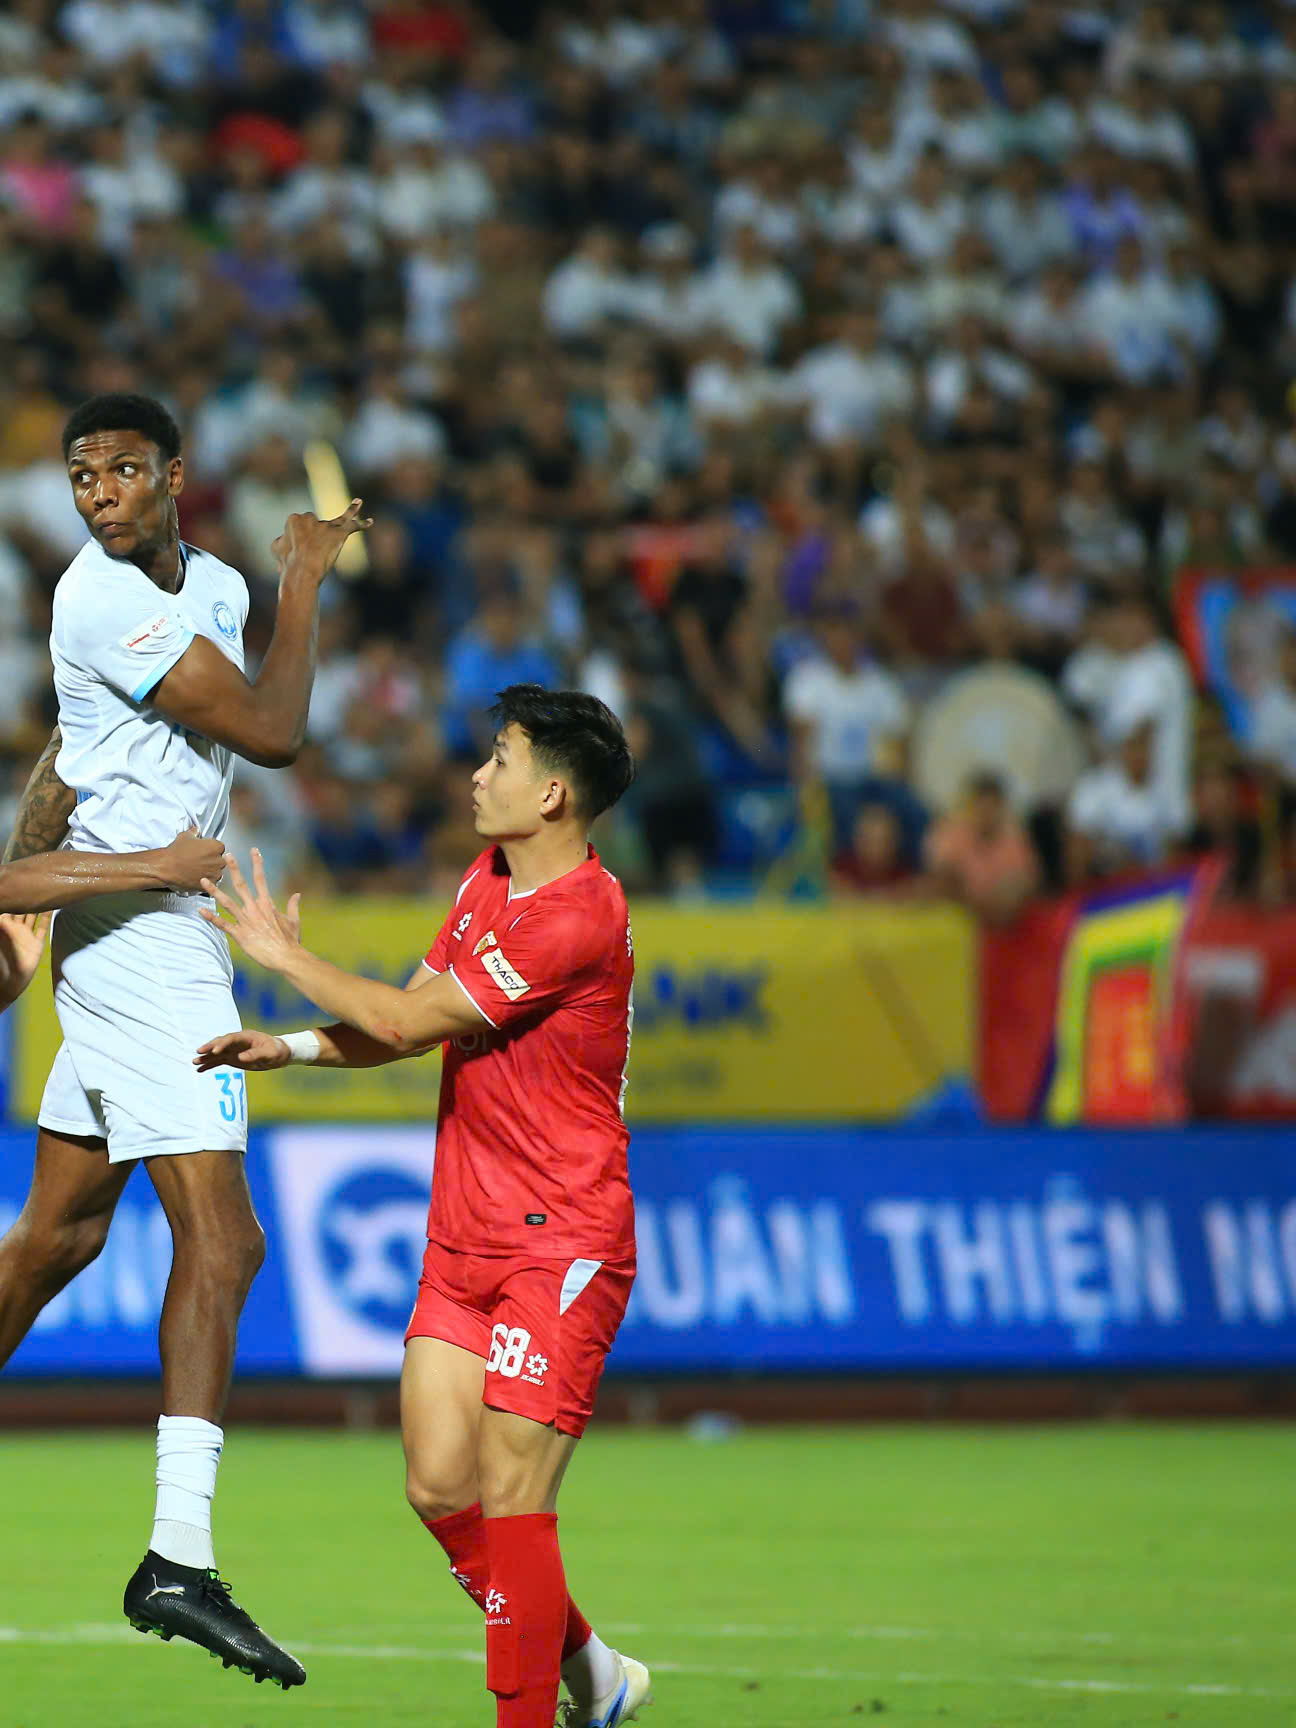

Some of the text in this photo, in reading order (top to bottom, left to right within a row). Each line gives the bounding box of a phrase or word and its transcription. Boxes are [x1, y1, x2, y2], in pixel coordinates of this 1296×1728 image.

[215, 1072, 244, 1122] 37
[629, 1170, 854, 1326] UÂN
[866, 1170, 1182, 1354] THIỆN
[486, 1323, 532, 1378] 68
